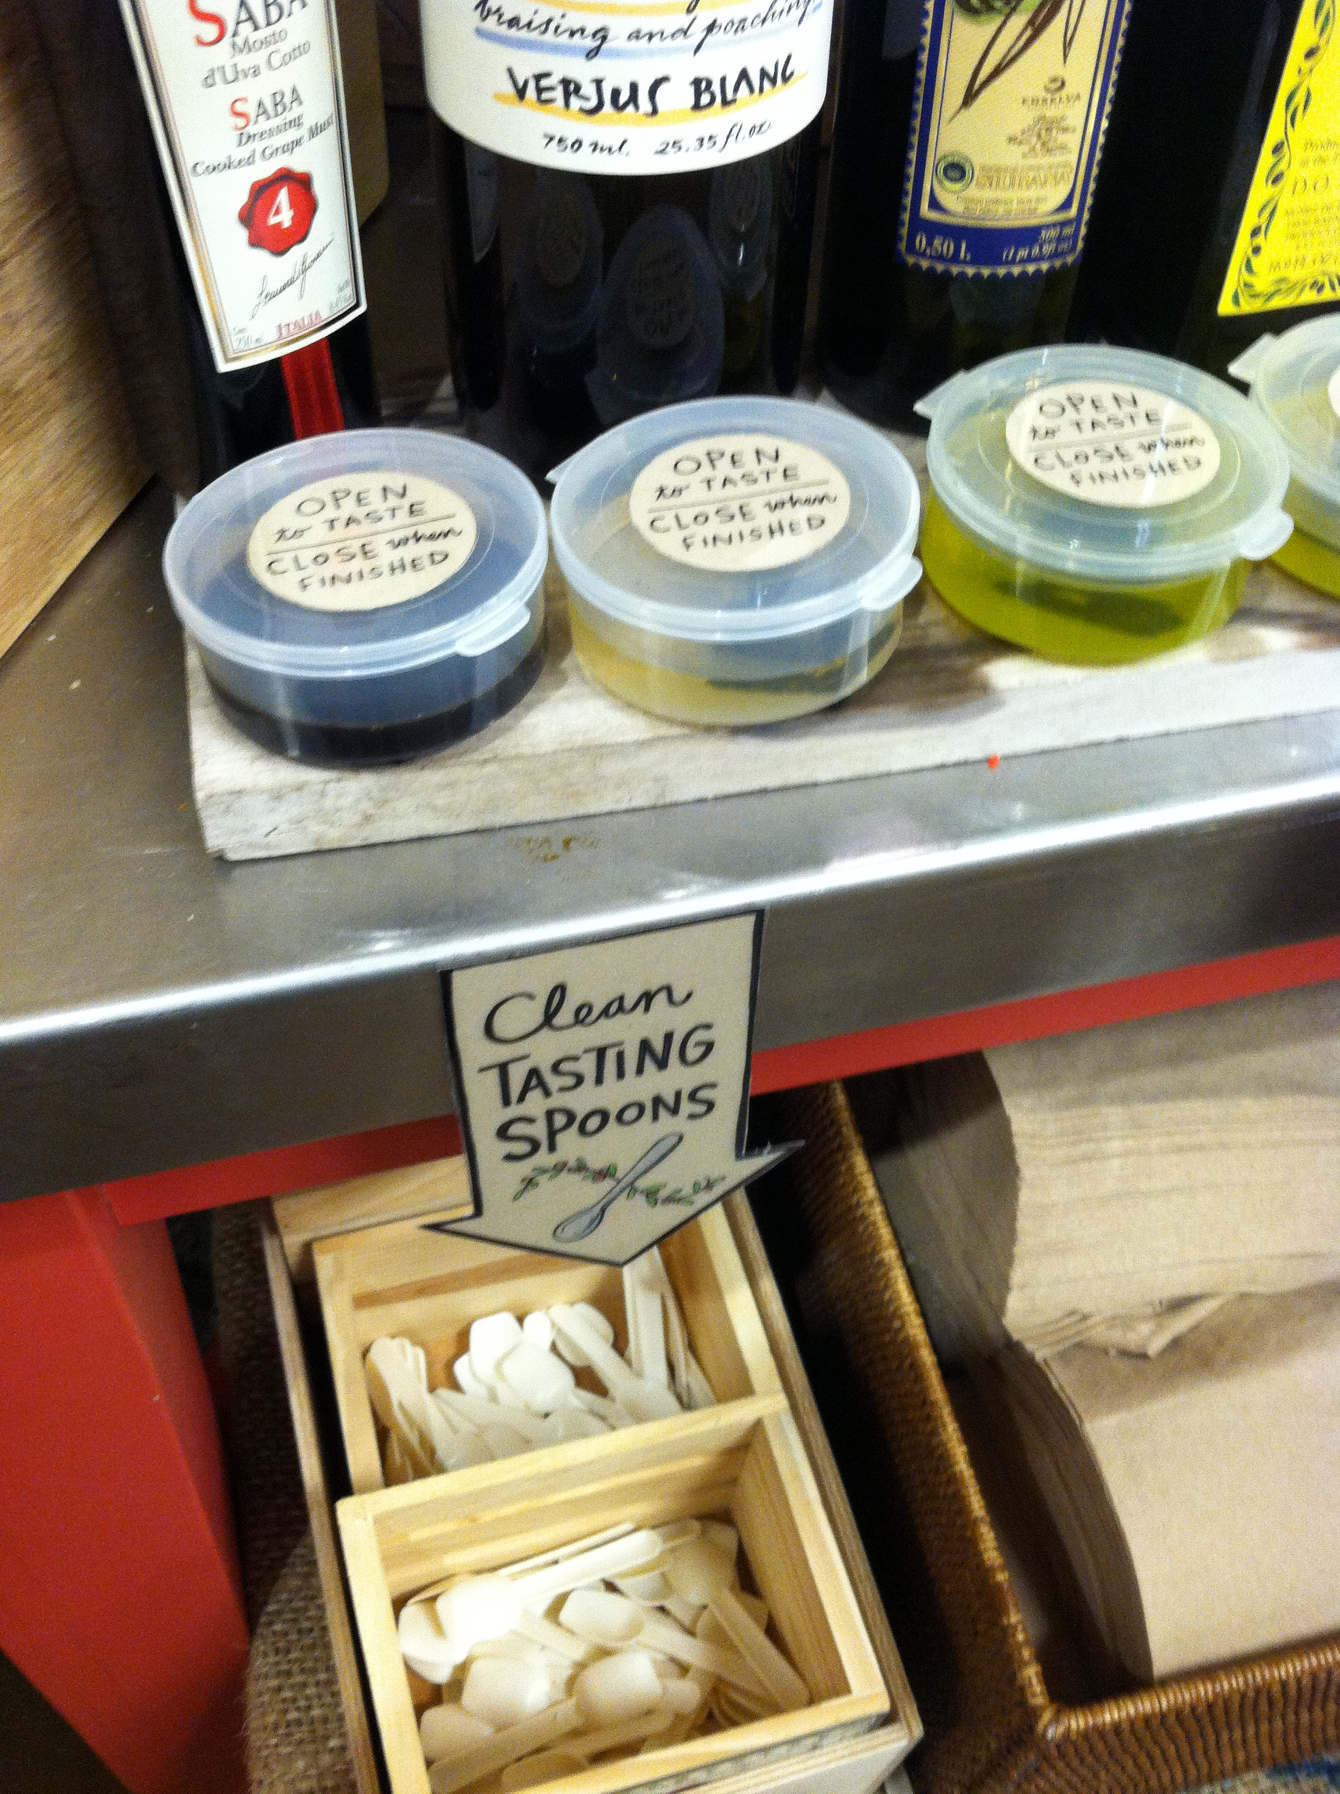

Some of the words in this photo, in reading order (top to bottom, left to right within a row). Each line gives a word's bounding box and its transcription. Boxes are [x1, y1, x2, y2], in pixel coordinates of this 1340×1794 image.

[230, 28, 288, 58] Mosto
[474, 0, 611, 61] braising
[626, 15, 698, 43] and
[202, 63, 261, 89] d'Uva
[266, 41, 311, 72] Cotto
[507, 66, 671, 117] VERJUS
[691, 53, 795, 111] BLANC
[230, 84, 304, 132] SABA
[236, 113, 304, 148] Dressing
[542, 131, 583, 154] 750
[653, 134, 718, 156] 25.35
[191, 149, 256, 178] Cooked
[260, 134, 305, 162] Grape
[267, 186, 295, 230] 4
[1039, 391, 1138, 419] OPEN
[1071, 408, 1162, 434] TASTE
[673, 446, 780, 476] OPEN
[1033, 443, 1133, 471] CLOSE
[1137, 436, 1205, 454] when
[1069, 455, 1202, 487] FINISHED
[295, 482, 407, 517] OPEN
[655, 484, 690, 501] to
[700, 463, 800, 492] TASTE
[274, 525, 312, 544] to
[322, 500, 426, 532] TASTE
[649, 502, 757, 534] CLOSE
[763, 491, 838, 514] when
[682, 513, 826, 552] FINISHED
[266, 541, 380, 576] CLOSE
[385, 524, 462, 550] when
[299, 549, 449, 592] FINISHED
[483, 981, 694, 1045] Clean
[477, 1023, 715, 1108] TASTING
[495, 1082, 718, 1163] SPOONS
